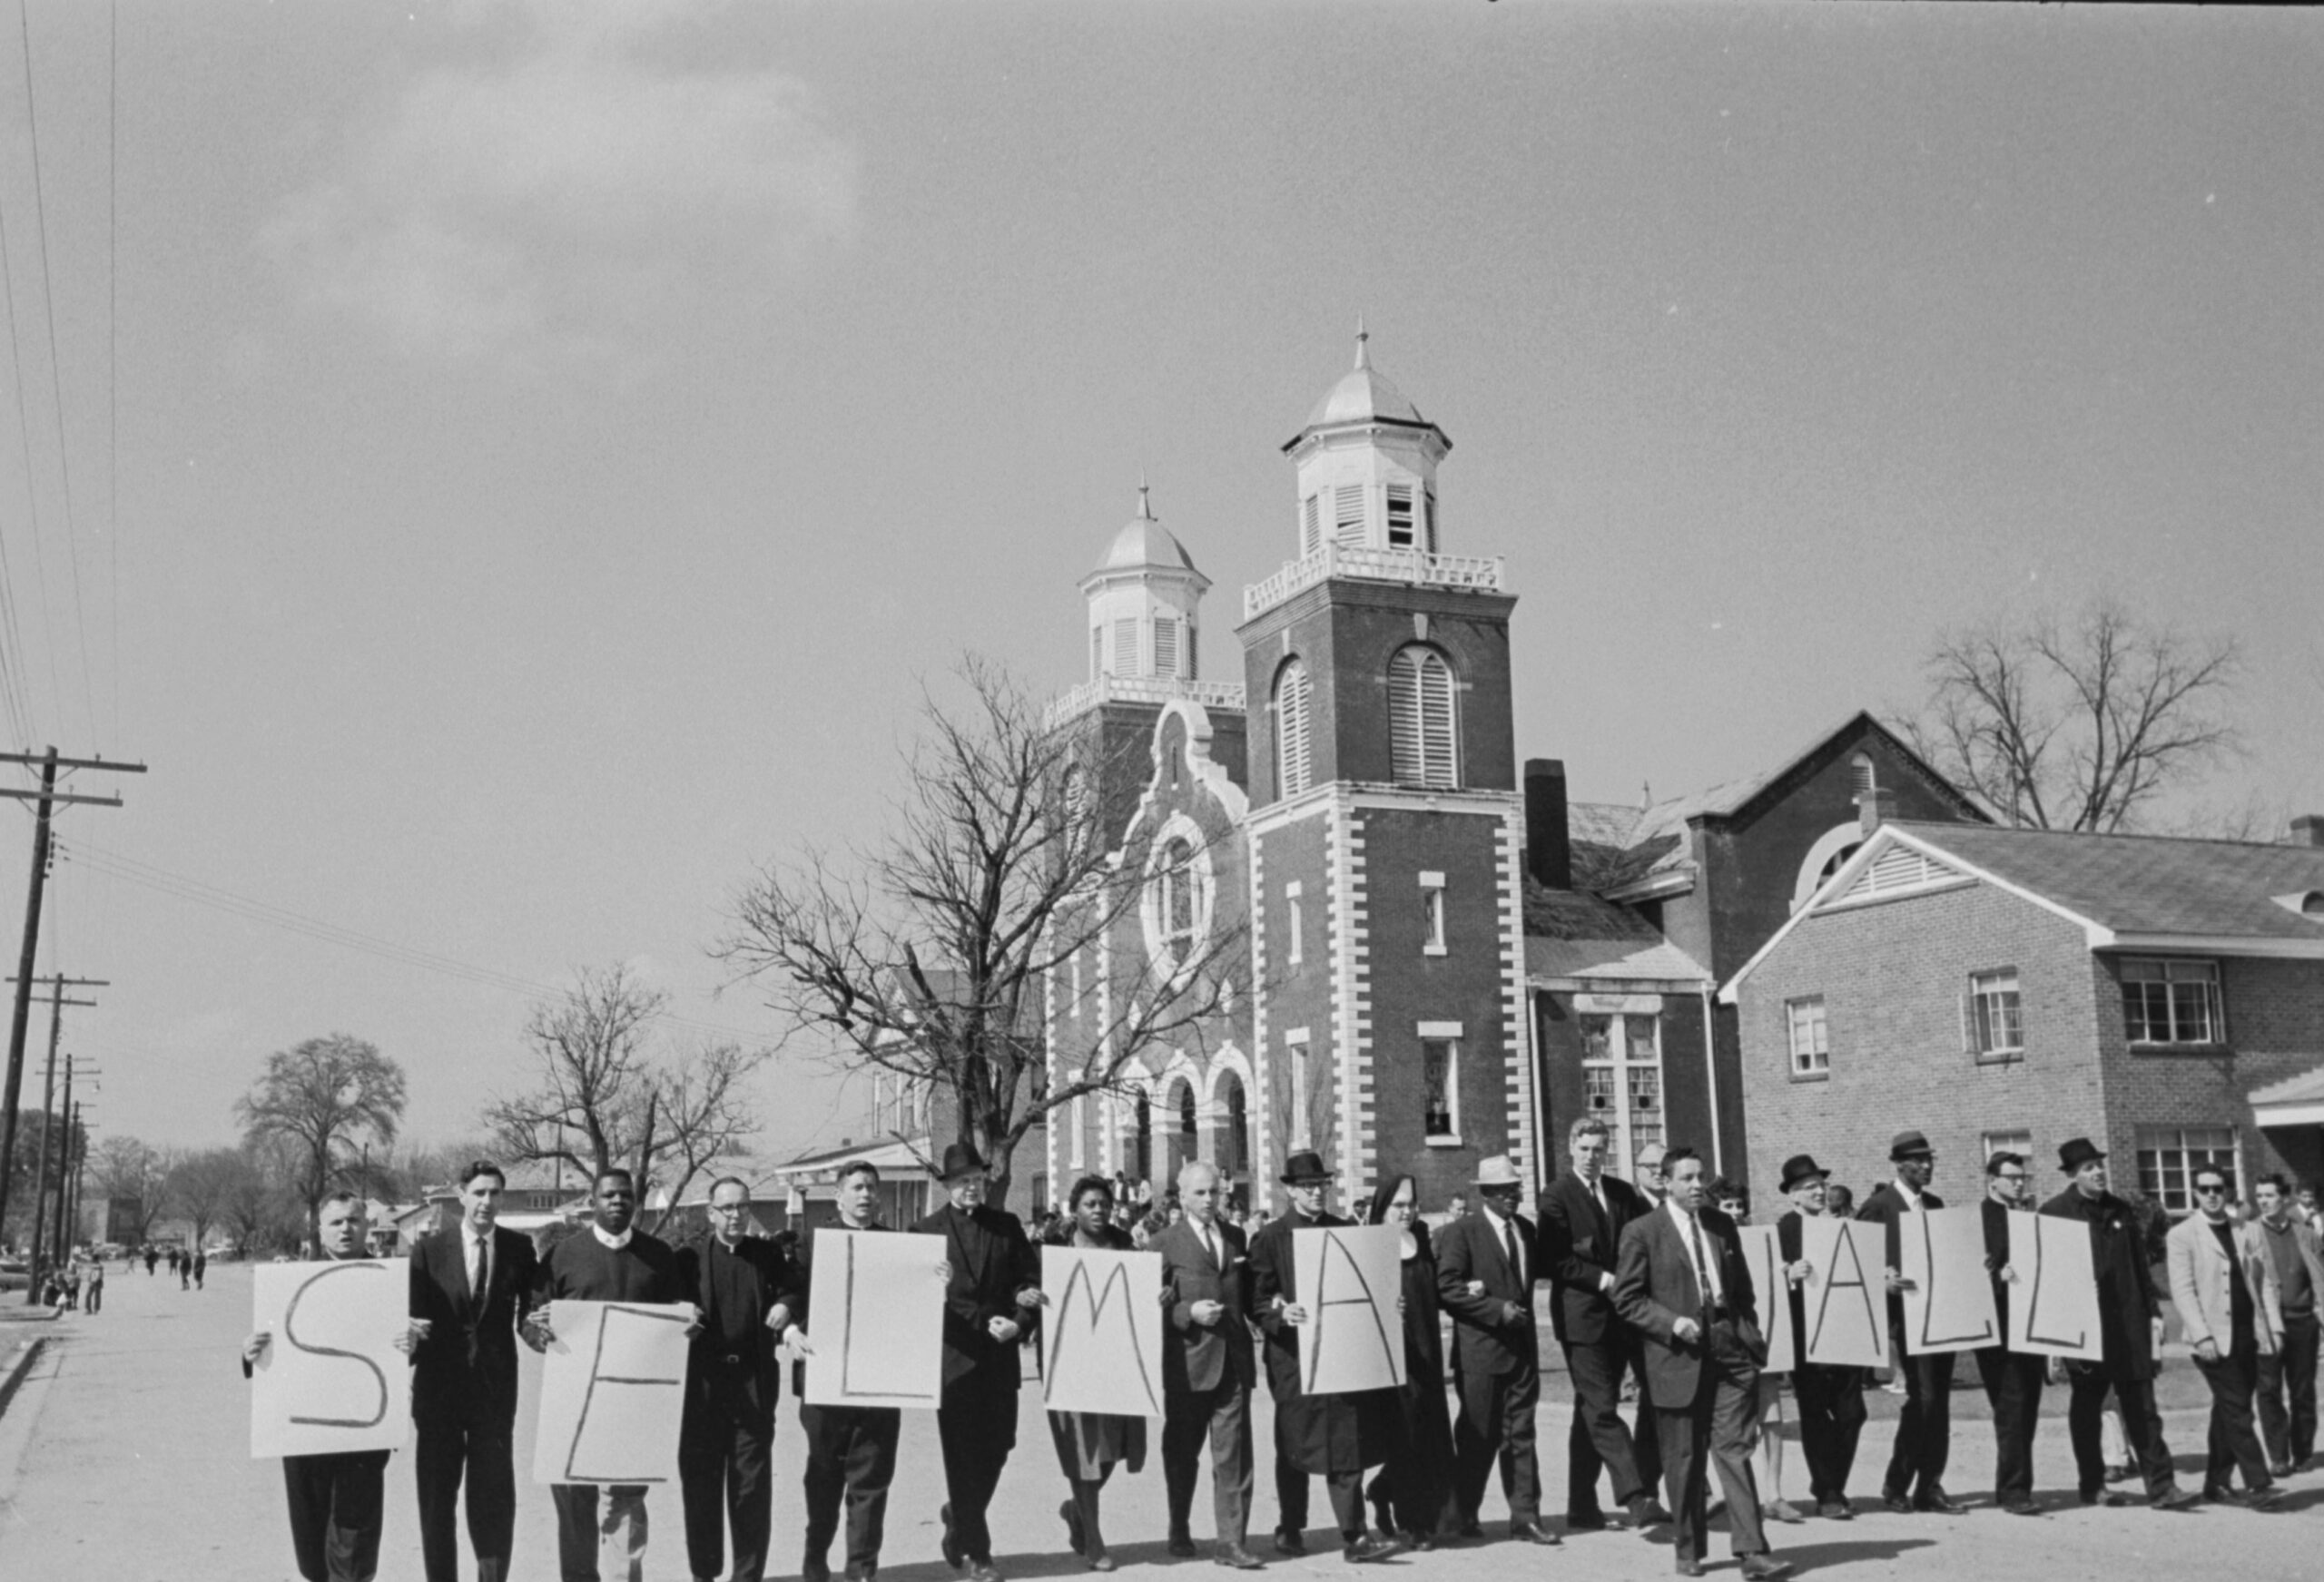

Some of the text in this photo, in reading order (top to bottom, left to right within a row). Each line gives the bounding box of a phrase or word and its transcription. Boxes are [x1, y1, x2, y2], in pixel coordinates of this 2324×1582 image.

[285, 1261, 389, 1429] S
[841, 1233, 935, 1400] L
[1044, 1258, 1161, 1416] M
[1307, 1229, 1399, 1394] A
[1808, 1222, 1881, 1357] A
[1921, 1210, 1994, 1346] L
[2026, 1214, 2085, 1349] L
[564, 1303, 692, 1483] E
